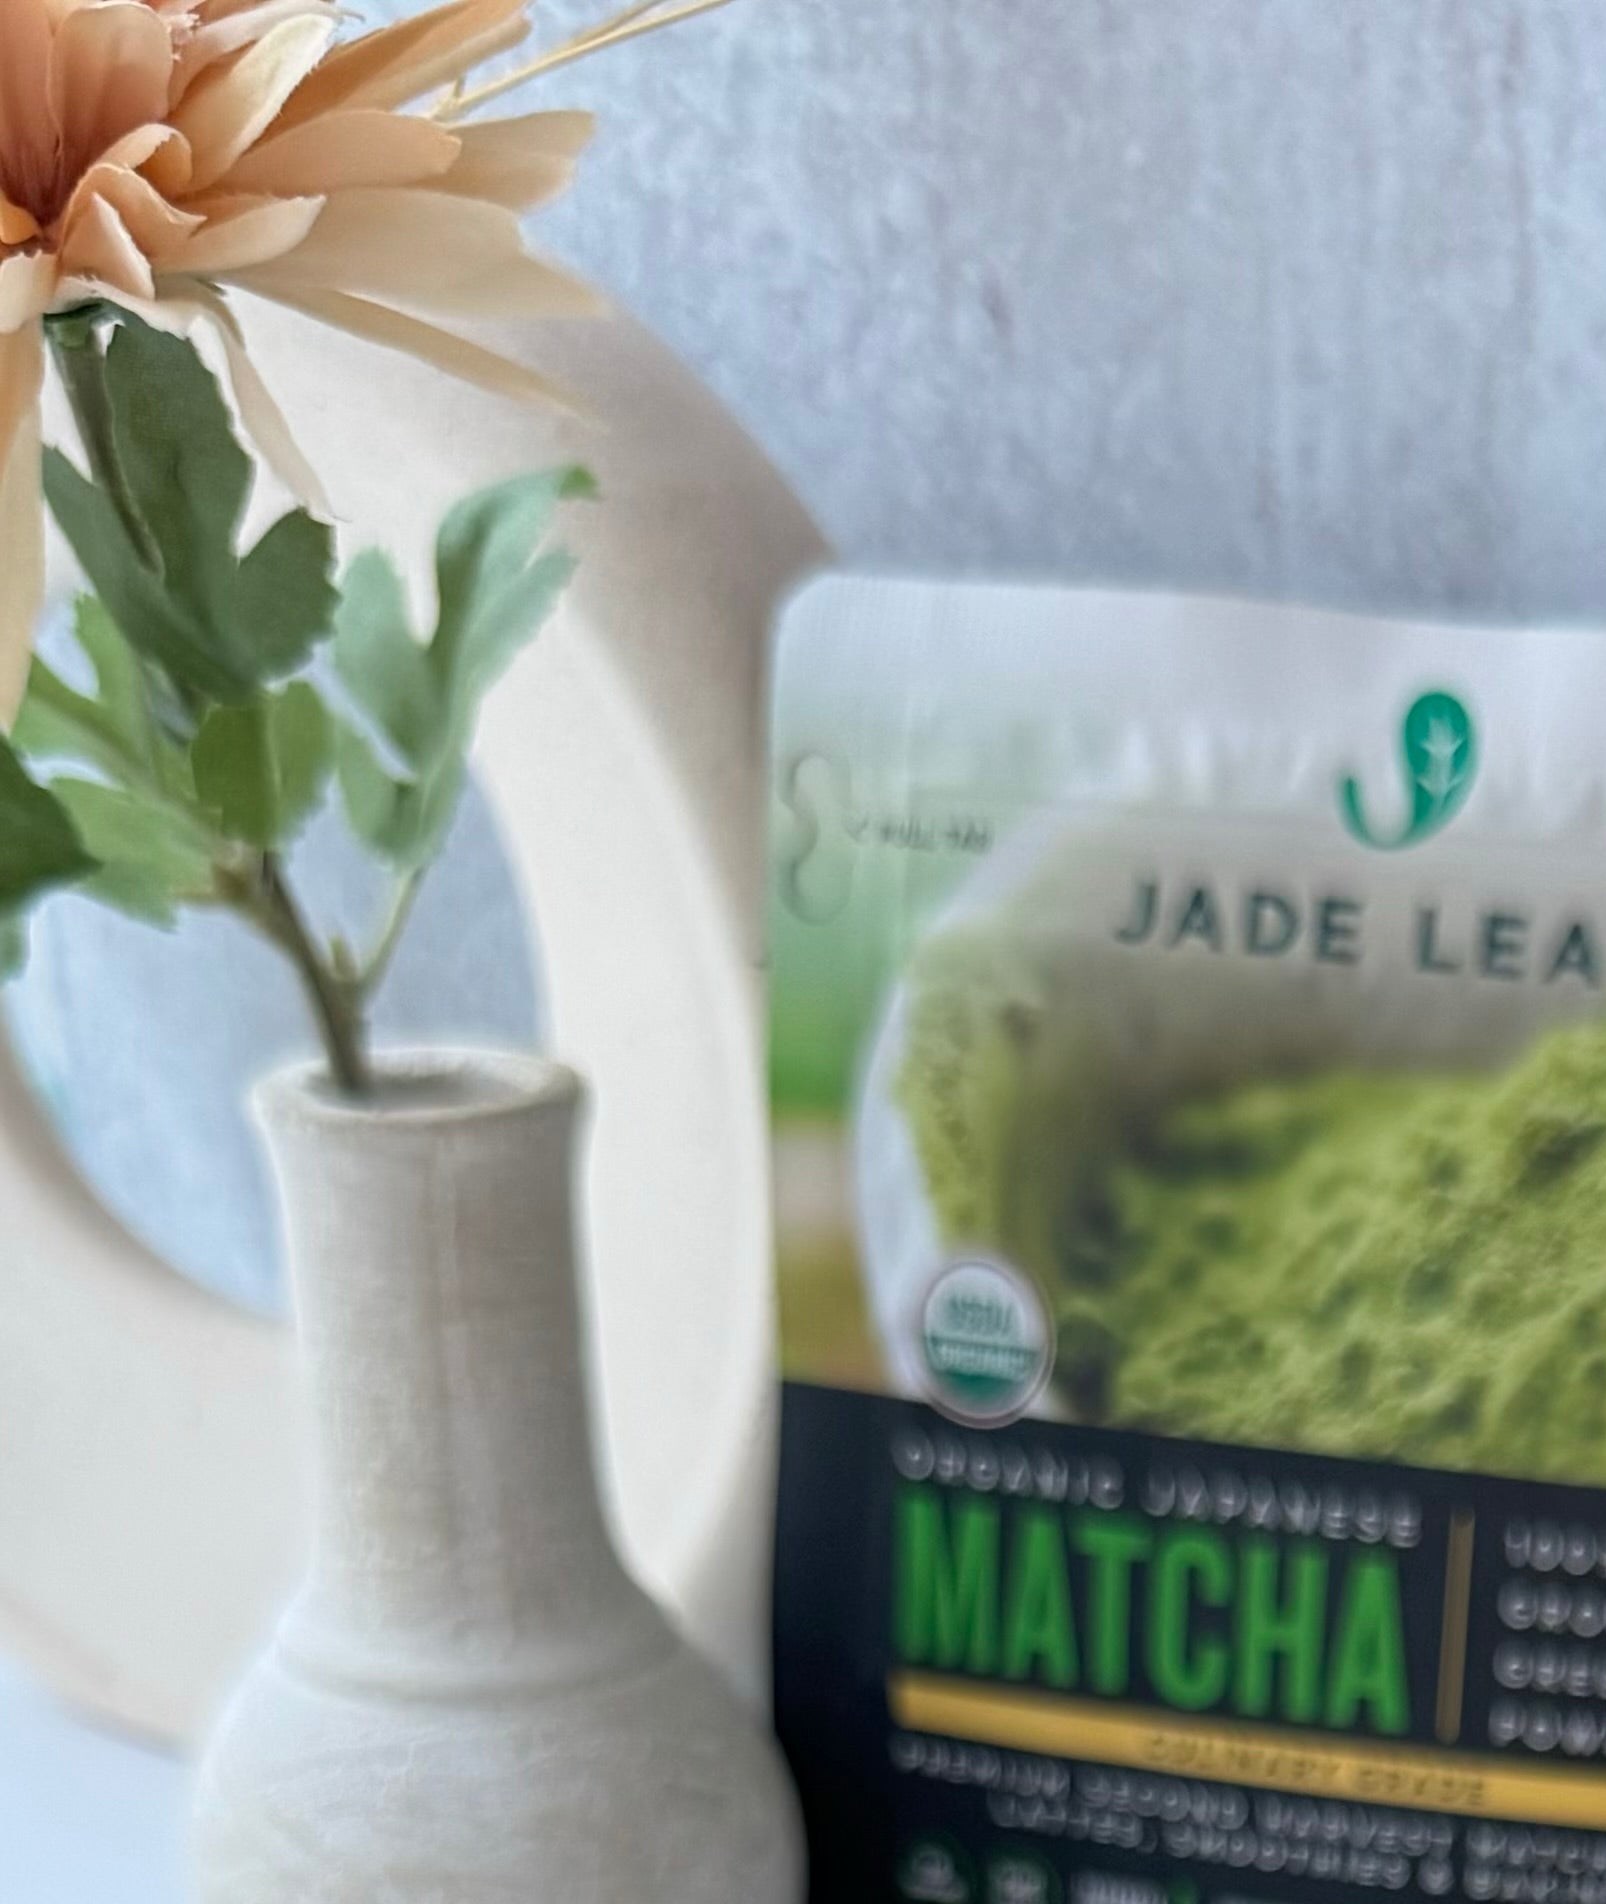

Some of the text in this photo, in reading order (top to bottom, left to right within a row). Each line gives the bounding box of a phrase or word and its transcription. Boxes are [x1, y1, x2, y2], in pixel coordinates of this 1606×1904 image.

[1113, 872, 1367, 968] JADE
[892, 1426, 1423, 1549] ORGANIC JAPANESE
[895, 1482, 1413, 1738] MATCHA
[1147, 1730, 1486, 1809] CULINARY GRADE
